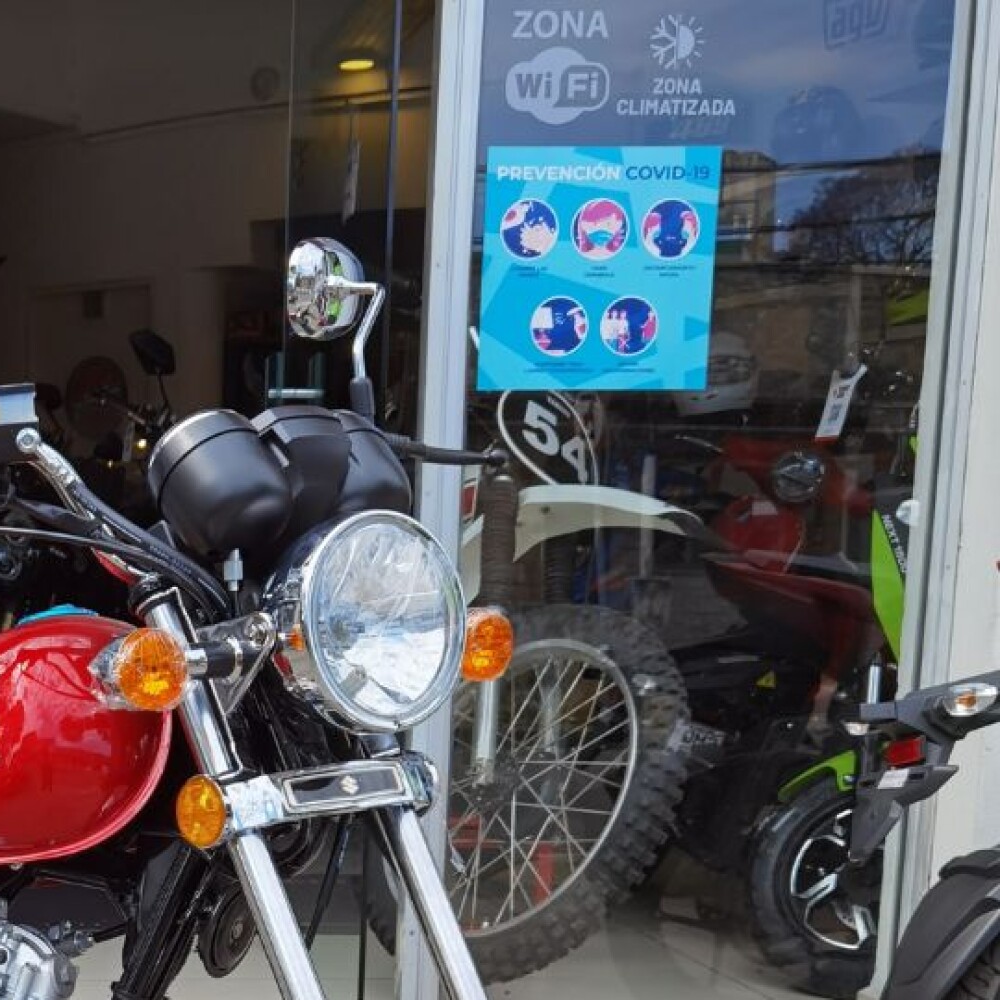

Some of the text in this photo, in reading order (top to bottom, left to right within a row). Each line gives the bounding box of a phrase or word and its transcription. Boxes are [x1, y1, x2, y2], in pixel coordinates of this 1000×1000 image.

[511, 10, 609, 39] ZONA
[653, 77, 702, 95] ZONA
[616, 98, 736, 116] CLIMATIZADA
[497, 163, 711, 182] PREVENCIÓN COVID-19
